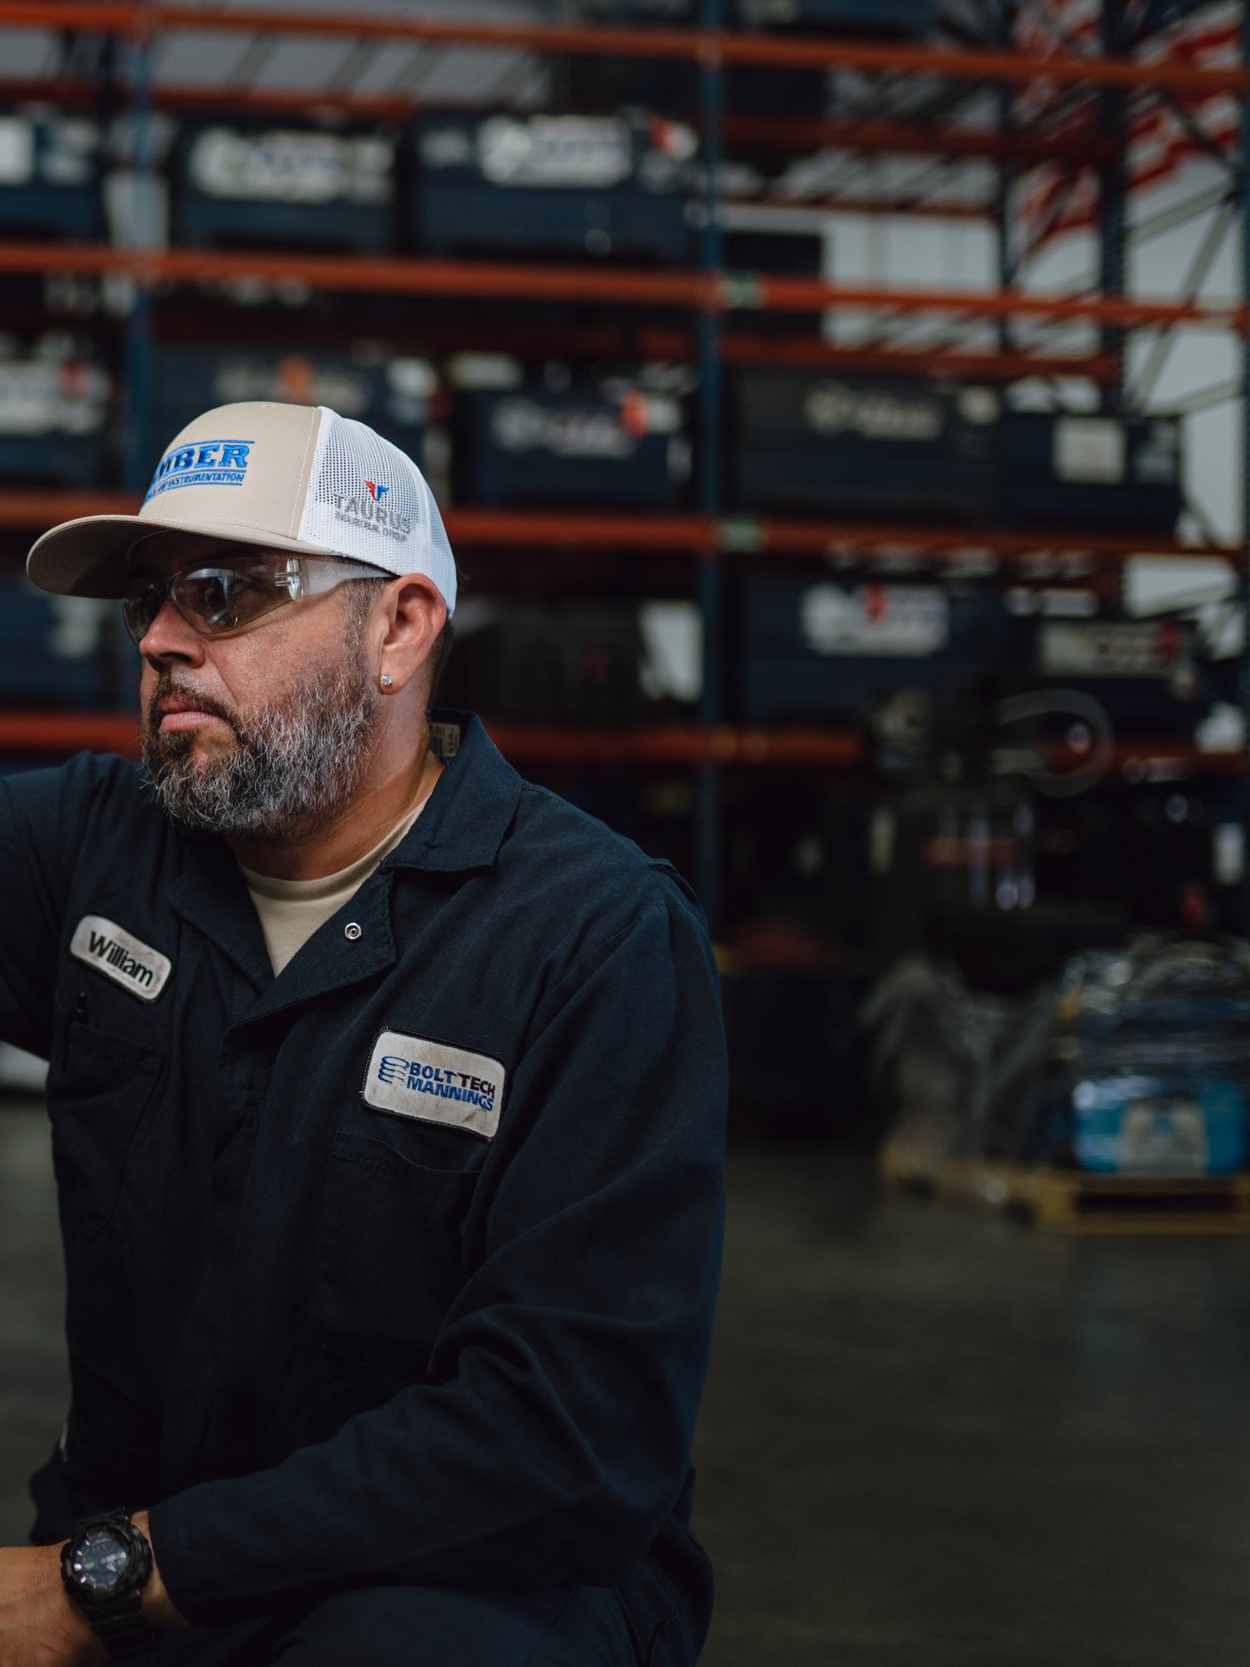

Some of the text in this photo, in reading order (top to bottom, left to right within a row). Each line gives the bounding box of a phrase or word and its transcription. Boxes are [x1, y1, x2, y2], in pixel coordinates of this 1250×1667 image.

[333, 493, 411, 534] TAURUS
[88, 930, 154, 987] William
[406, 1075, 495, 1112] MANNINGS
[410, 1061, 496, 1099] BOLT TECH
